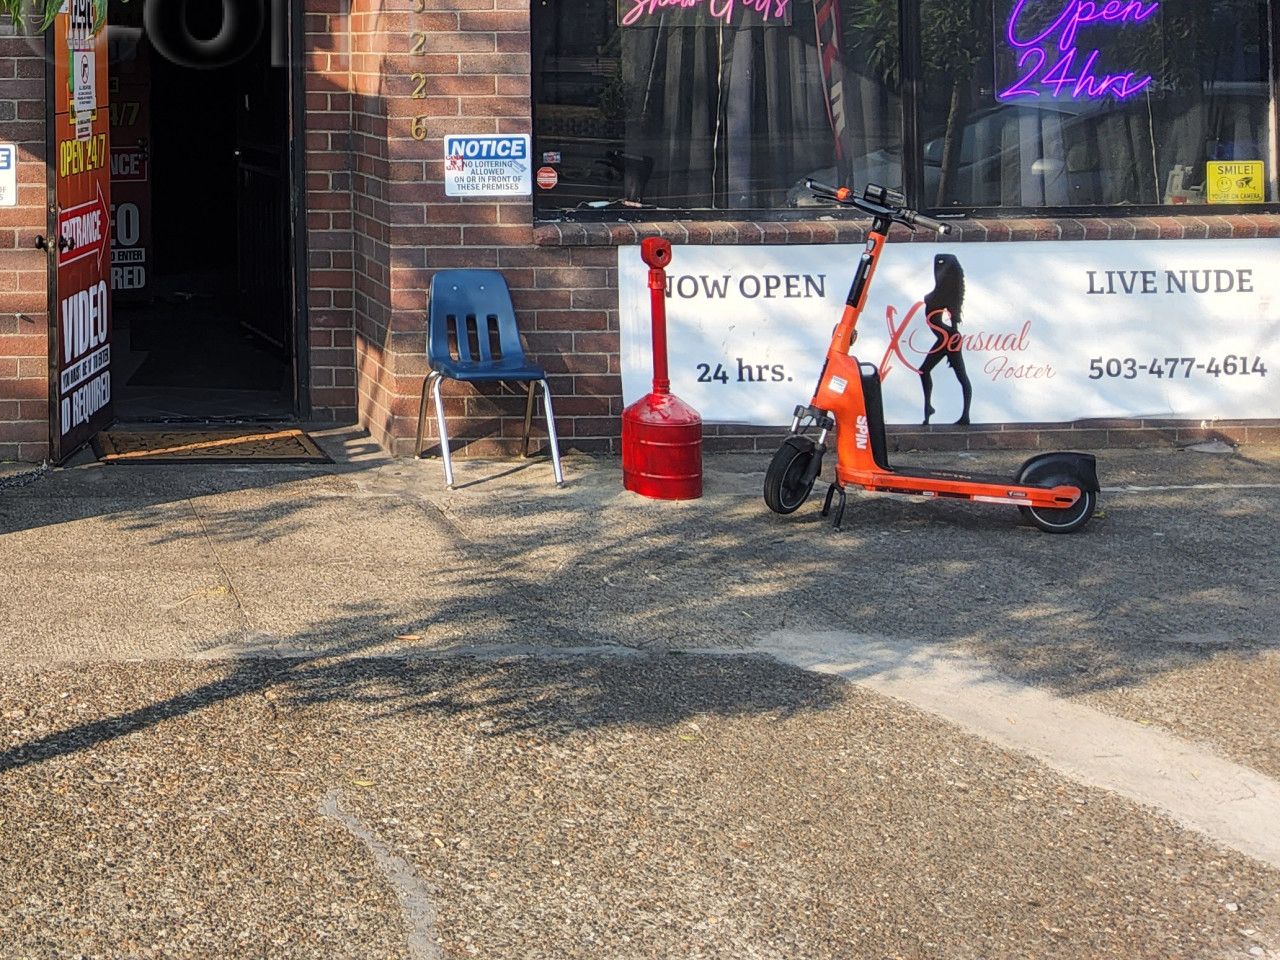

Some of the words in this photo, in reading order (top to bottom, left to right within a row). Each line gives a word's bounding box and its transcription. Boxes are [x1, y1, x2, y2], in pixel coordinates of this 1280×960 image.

[60, 139, 84, 178] OPEN
[86, 133, 107, 171] 24/7
[451, 139, 524, 157] NOTICE
[463, 160, 473, 168] NO
[475, 160, 513, 168] LOITERING
[1217, 165, 1254, 175] SMILE!
[481, 183, 519, 191] PREMISES
[61, 209, 102, 254] ENTRANCE
[738, 274, 827, 299] OPEN
[1086, 270, 1158, 295] LIVE
[1165, 268, 1254, 294] NUDE
[62, 279, 109, 364] VIDEO
[696, 363, 729, 385] 24
[736, 357, 793, 383] hrs.
[983, 355, 1057, 382] Foster
[1088, 353, 1268, 380] 503-477-4614
[61, 396, 71, 436] ID
[72, 370, 111, 428] REQUIRED
[855, 415, 869, 450] SPIN
